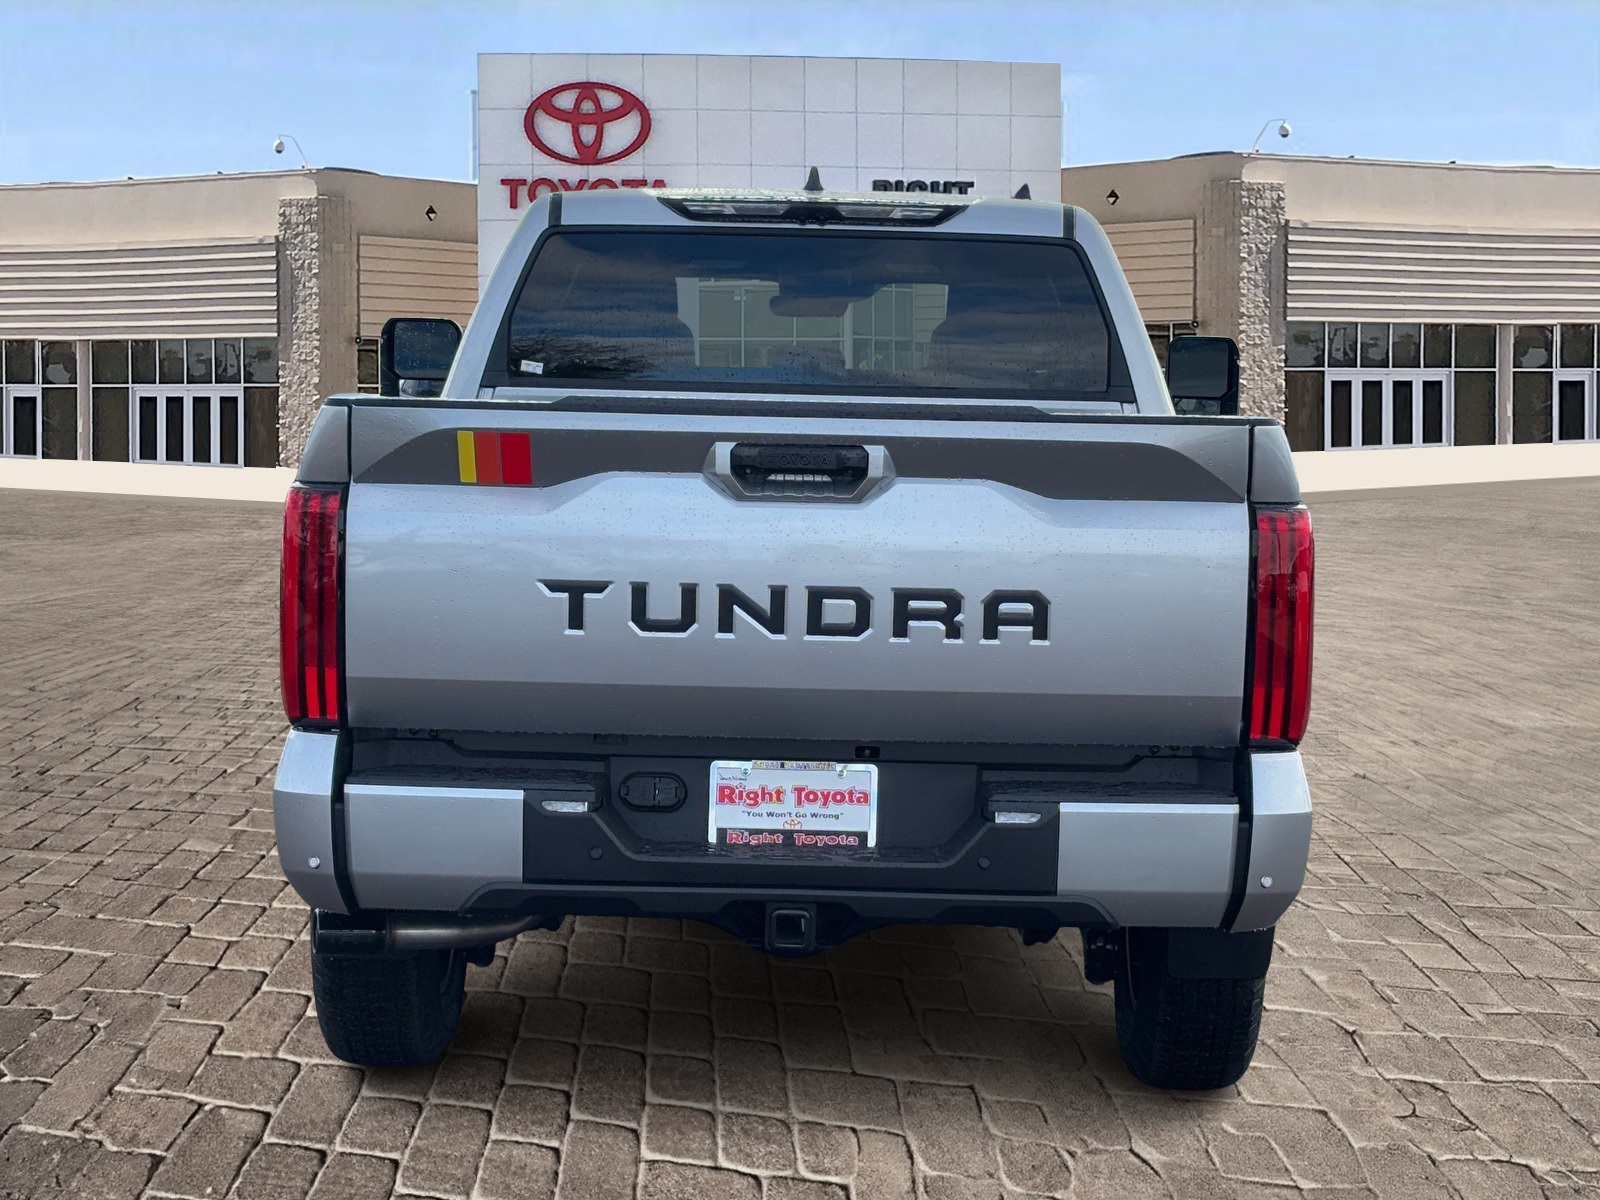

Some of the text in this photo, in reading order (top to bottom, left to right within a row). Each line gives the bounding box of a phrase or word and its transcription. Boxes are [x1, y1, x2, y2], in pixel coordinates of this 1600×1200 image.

[536, 579, 1051, 645] TUNDRA
[716, 783, 871, 809] Right Toyota
[795, 811, 807, 819] Go
[726, 831, 859, 847] Right Toyota
